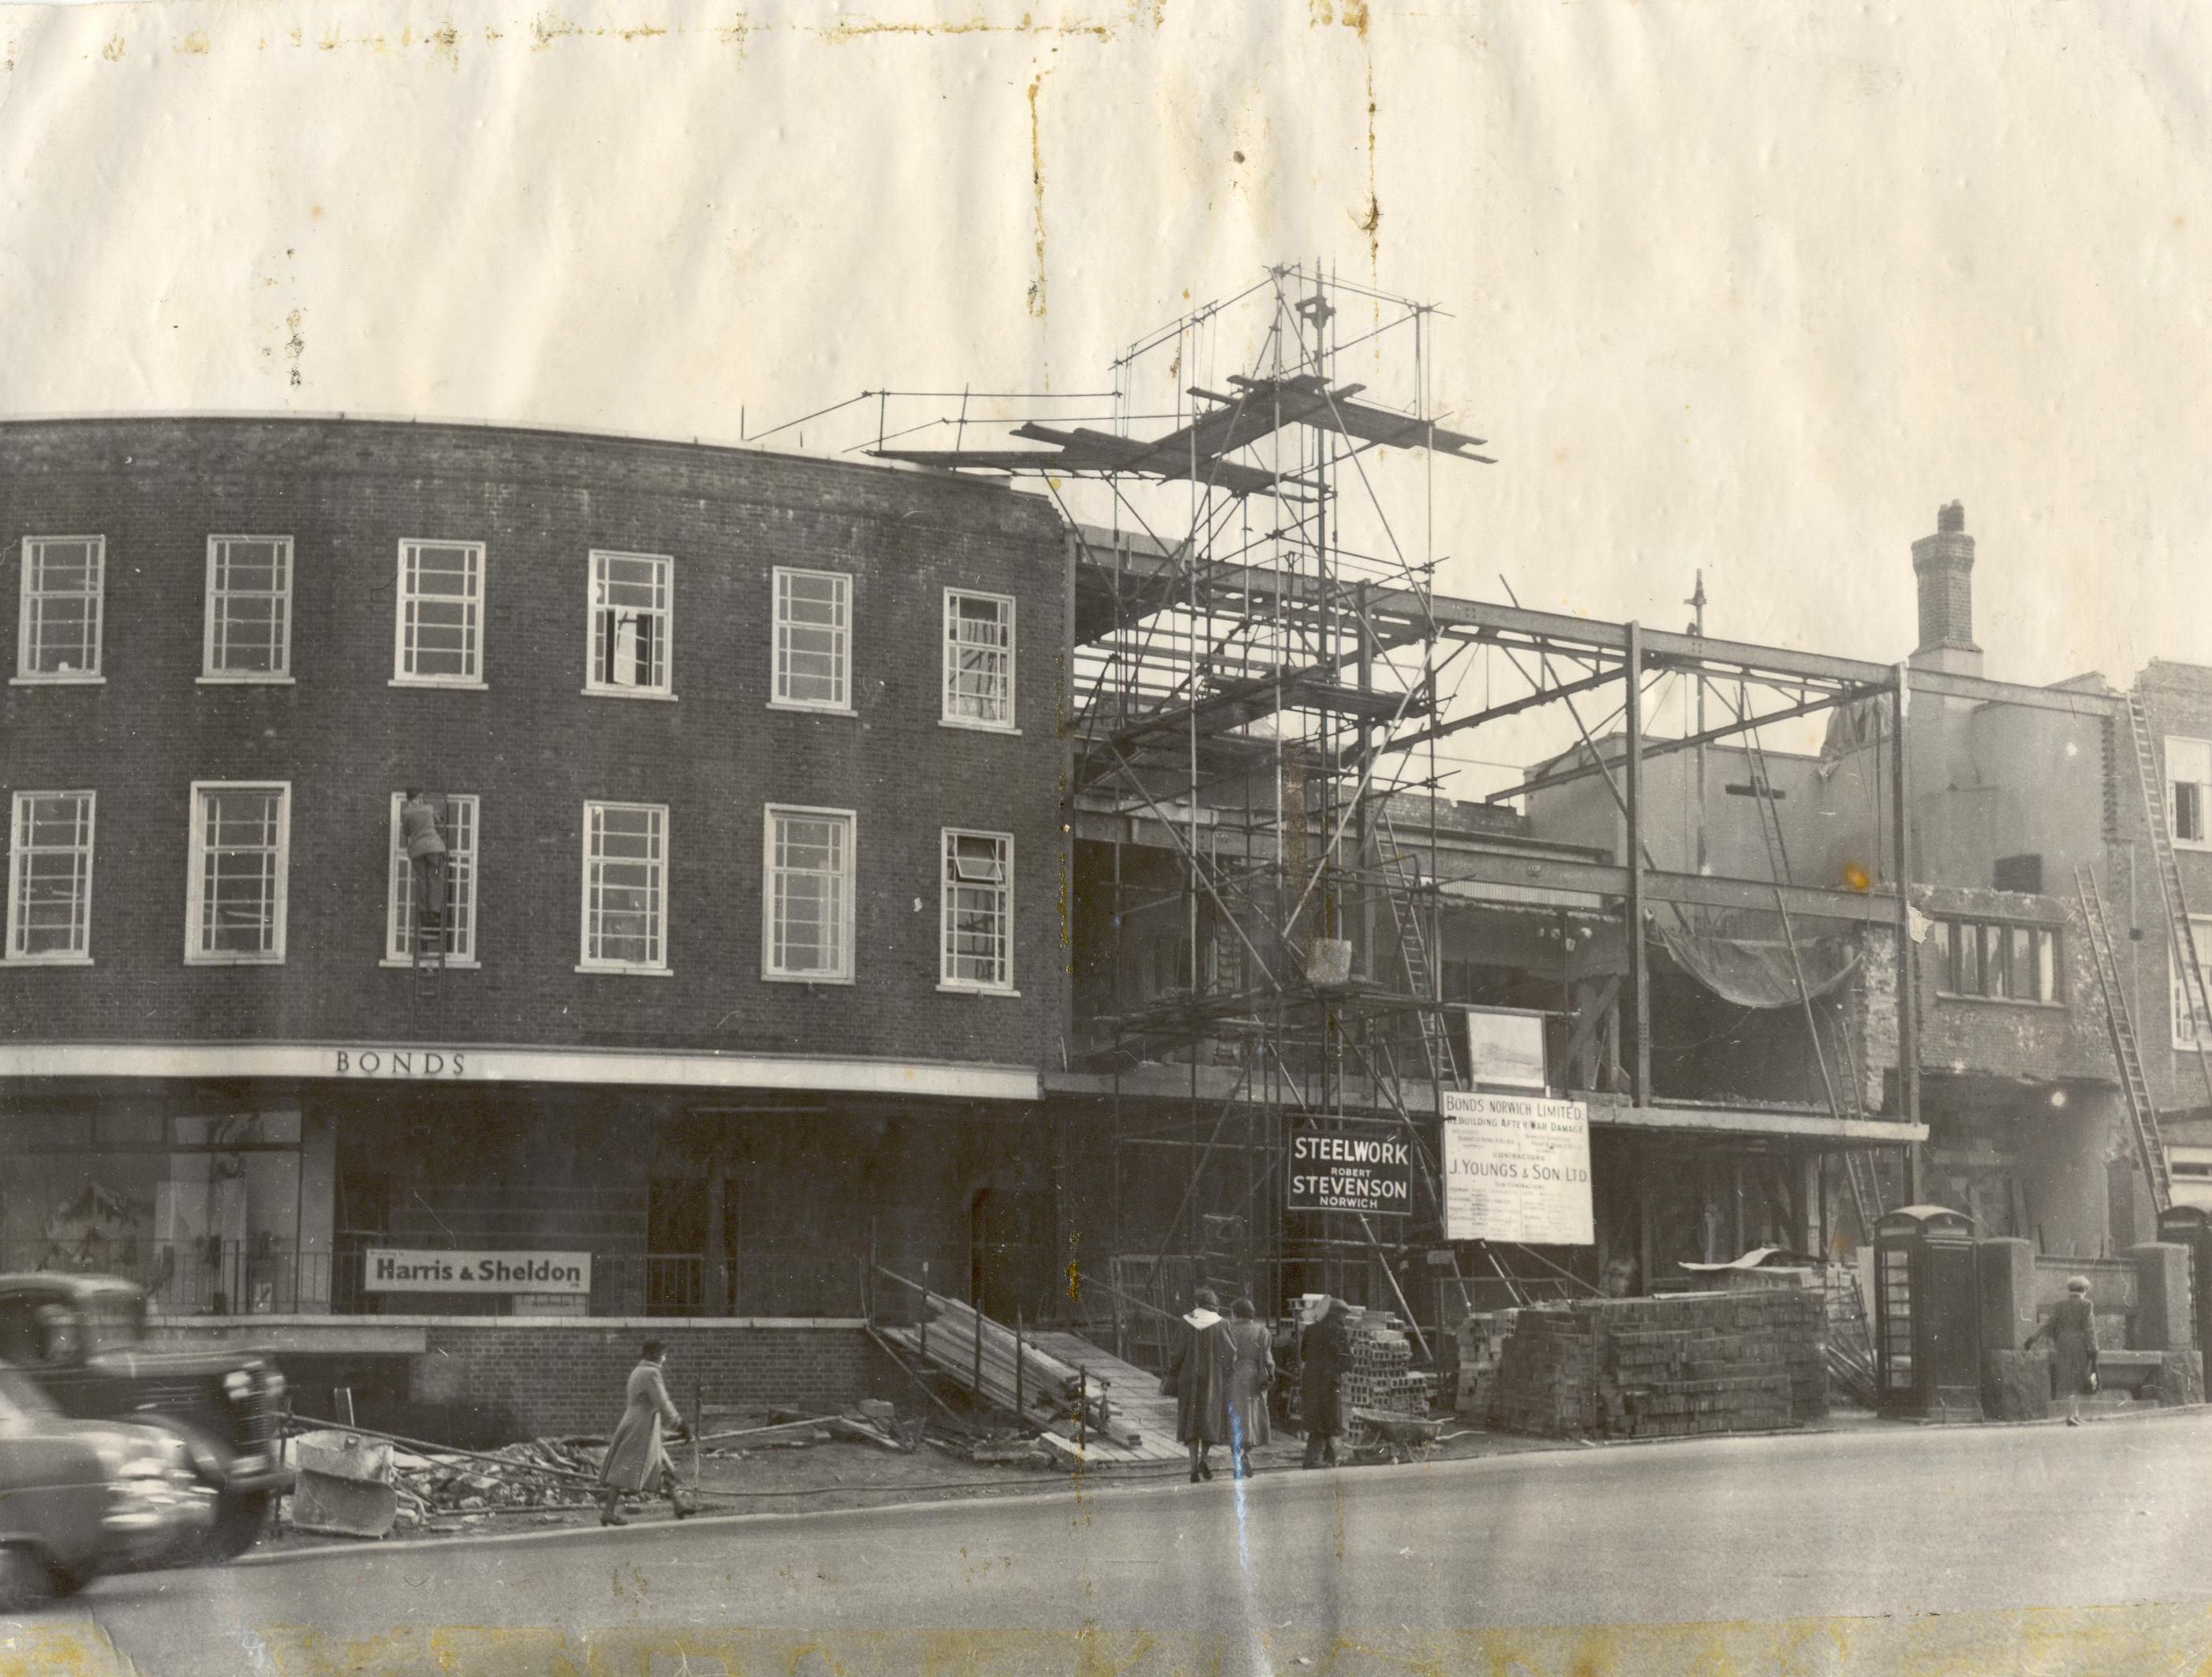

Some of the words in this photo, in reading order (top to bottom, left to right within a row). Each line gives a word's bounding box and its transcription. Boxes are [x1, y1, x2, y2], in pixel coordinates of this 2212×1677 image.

[336, 1051, 465, 1075] BONDS
[1447, 1095, 1484, 1112] BONDS
[1489, 1100, 1532, 1115] NORWICH
[1538, 1104, 1582, 1120] LIMITED
[1447, 1116, 1497, 1127] REBUILDING
[1501, 1119, 1527, 1130] AFTER
[1530, 1121, 1547, 1130] WAR
[1551, 1122, 1583, 1134] DAMAGE
[1294, 1137, 1409, 1165] STEELWORK
[1493, 1152, 1545, 1161] CONTRACTORS
[1331, 1167, 1372, 1178] ROBERT
[1533, 1164, 1560, 1181] SON
[1292, 1175, 1407, 1199] STEVENSON
[1320, 1196, 1378, 1209] NORWICH
[376, 1258, 453, 1280] Harris
[459, 1267, 474, 1280] &
[478, 1259, 581, 1281] Sheldon
